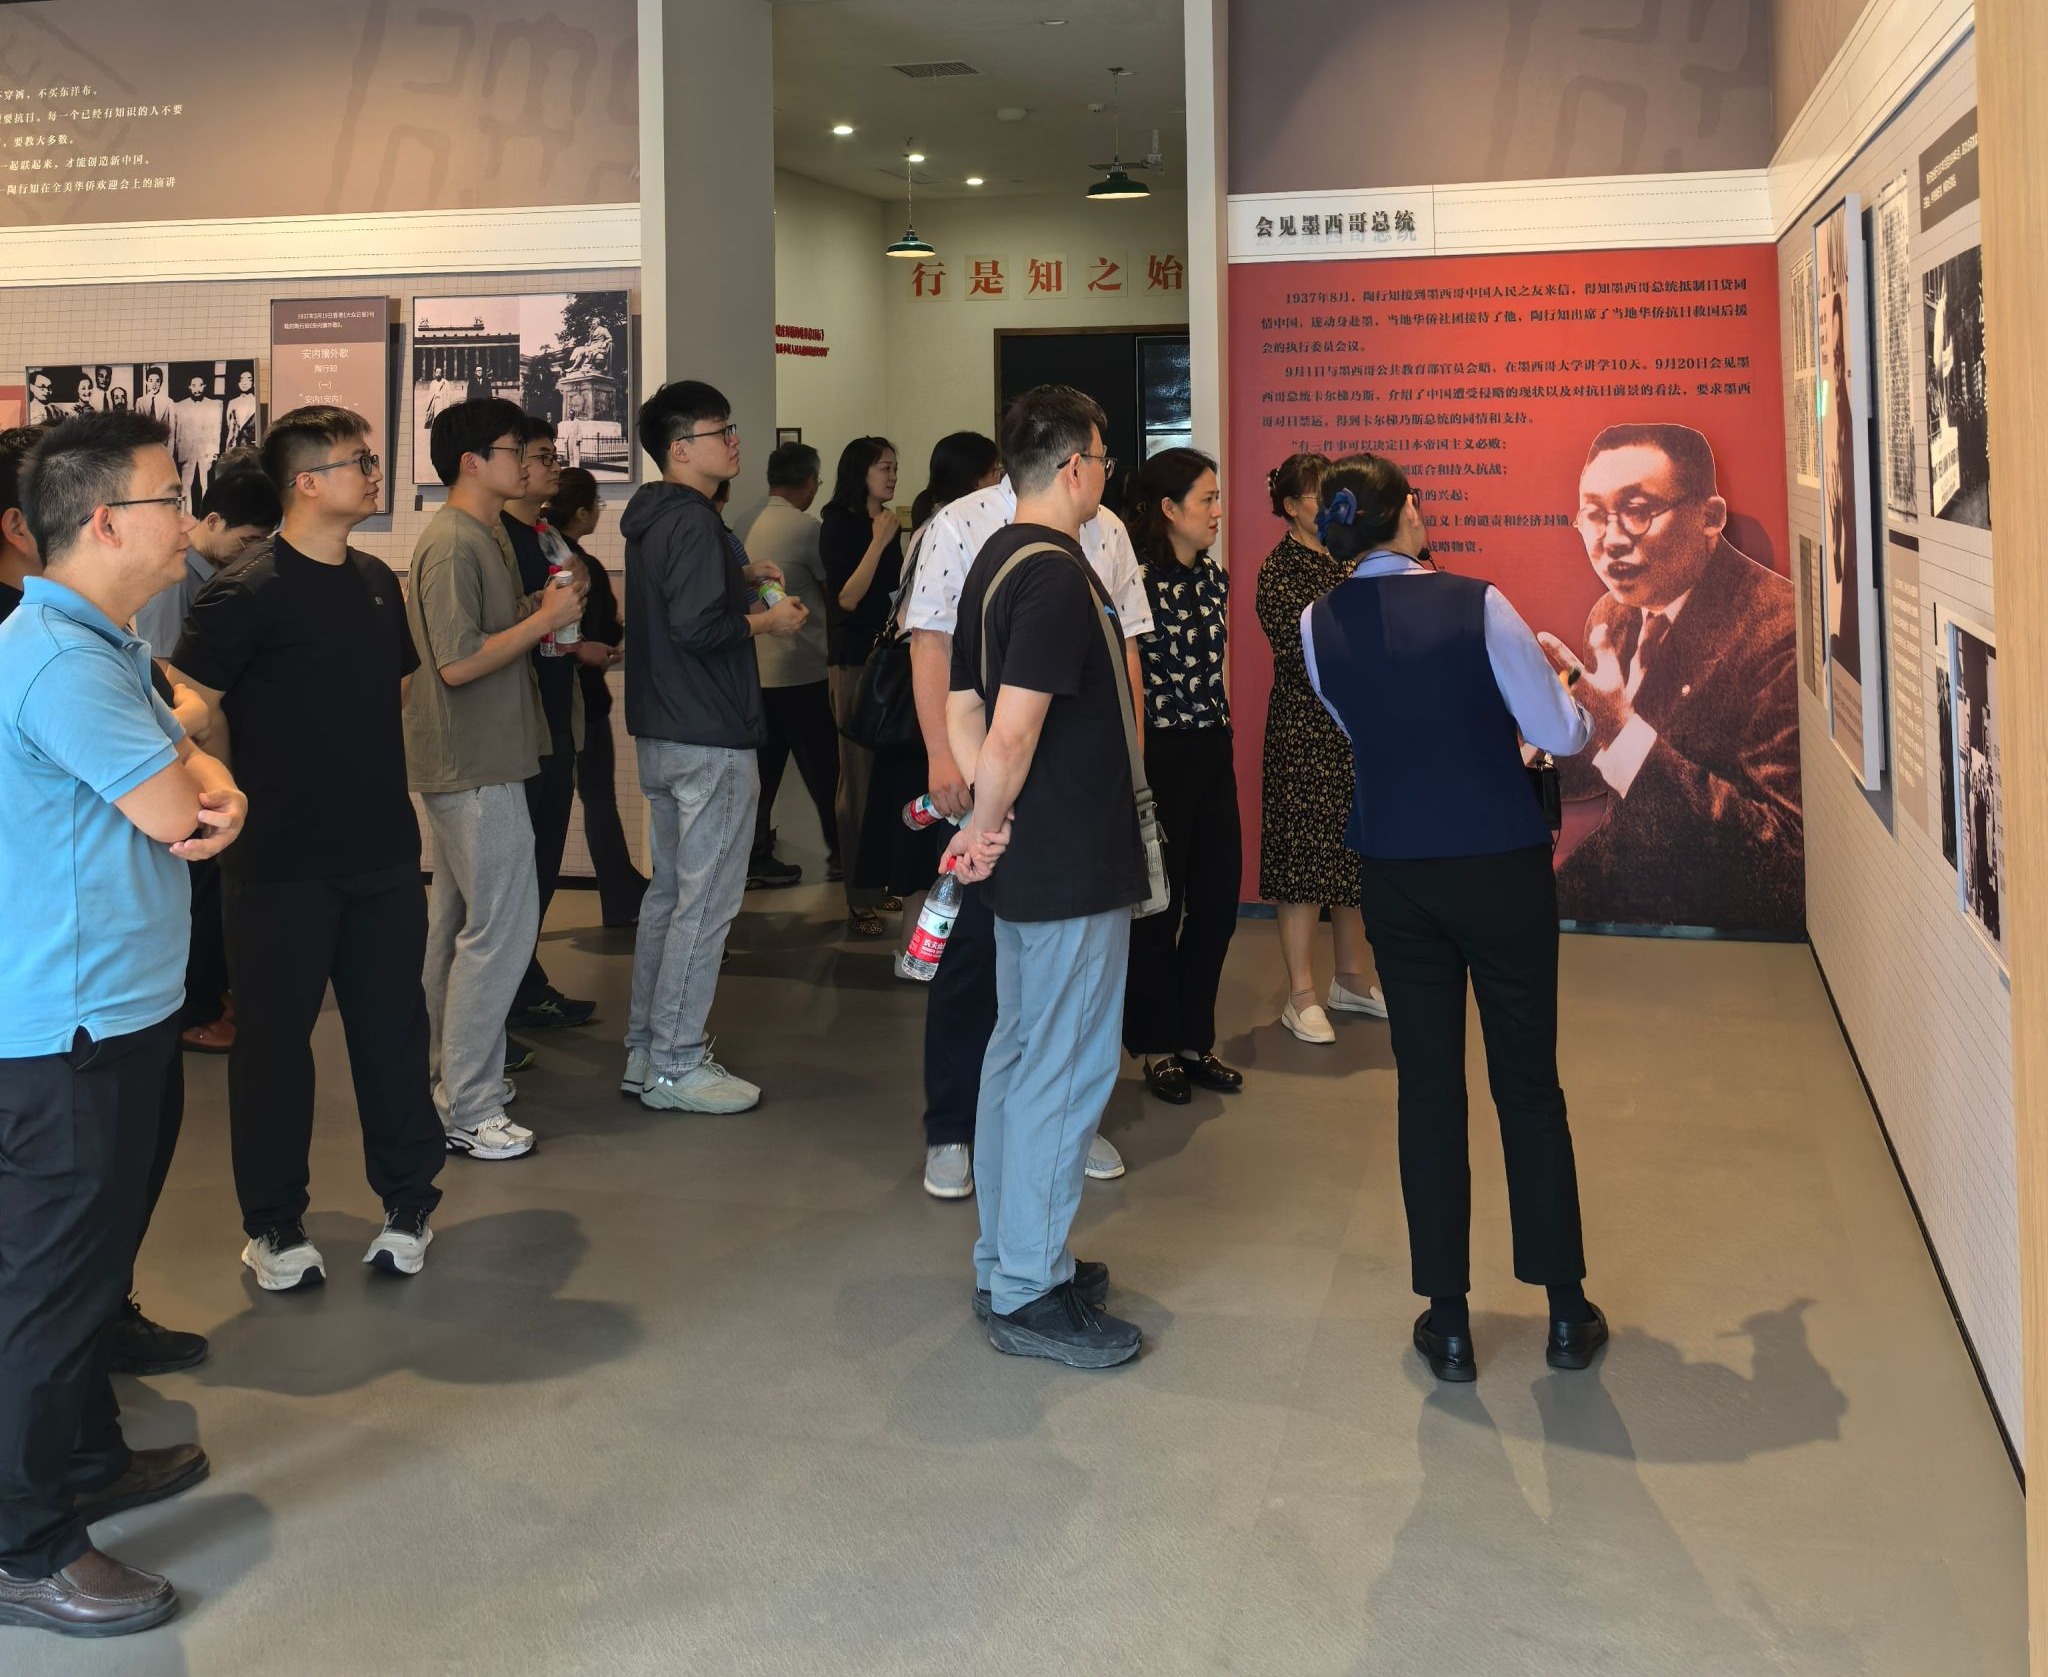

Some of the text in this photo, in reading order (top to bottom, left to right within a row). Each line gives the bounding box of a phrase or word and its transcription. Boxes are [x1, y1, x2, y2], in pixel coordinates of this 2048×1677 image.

[0, 85, 98, 101] 穿裤，不买东洋布。
[0, 104, 183, 125] 要抗日。每一个已经有知识的人不要
[0, 134, 74, 148] ，要教大多数。
[1254, 209, 1418, 239] 会见墨西哥总统
[911, 254, 1184, 297] 行是知之始
[1261, 340, 1366, 354] 会的执行委员会议。
[1418, 488, 1469, 502] 的兴起；
